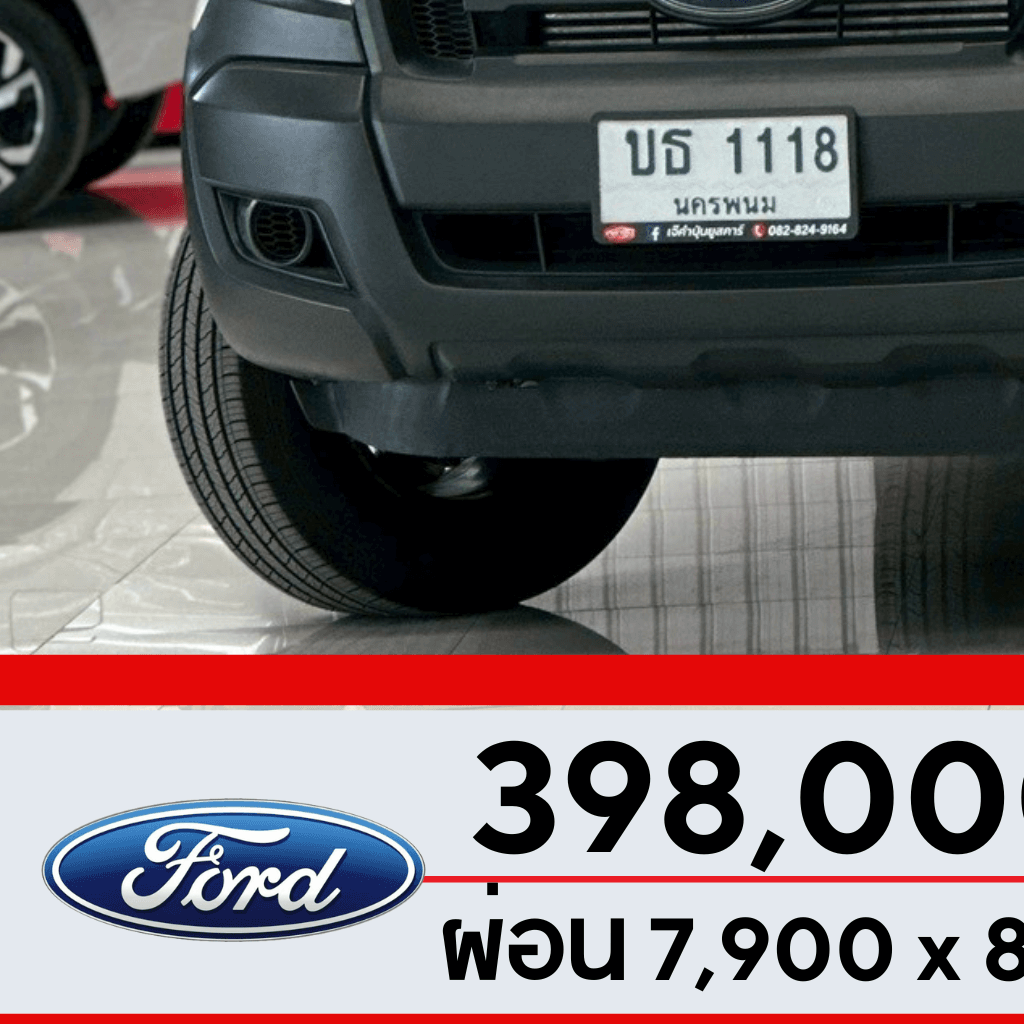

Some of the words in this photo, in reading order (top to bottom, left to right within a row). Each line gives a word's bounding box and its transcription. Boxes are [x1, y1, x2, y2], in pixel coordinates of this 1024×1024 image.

[625, 128, 693, 176] บธ
[726, 126, 839, 175] 1118
[673, 195, 776, 215] นครพนม
[768, 223, 848, 237] 082-824-9164
